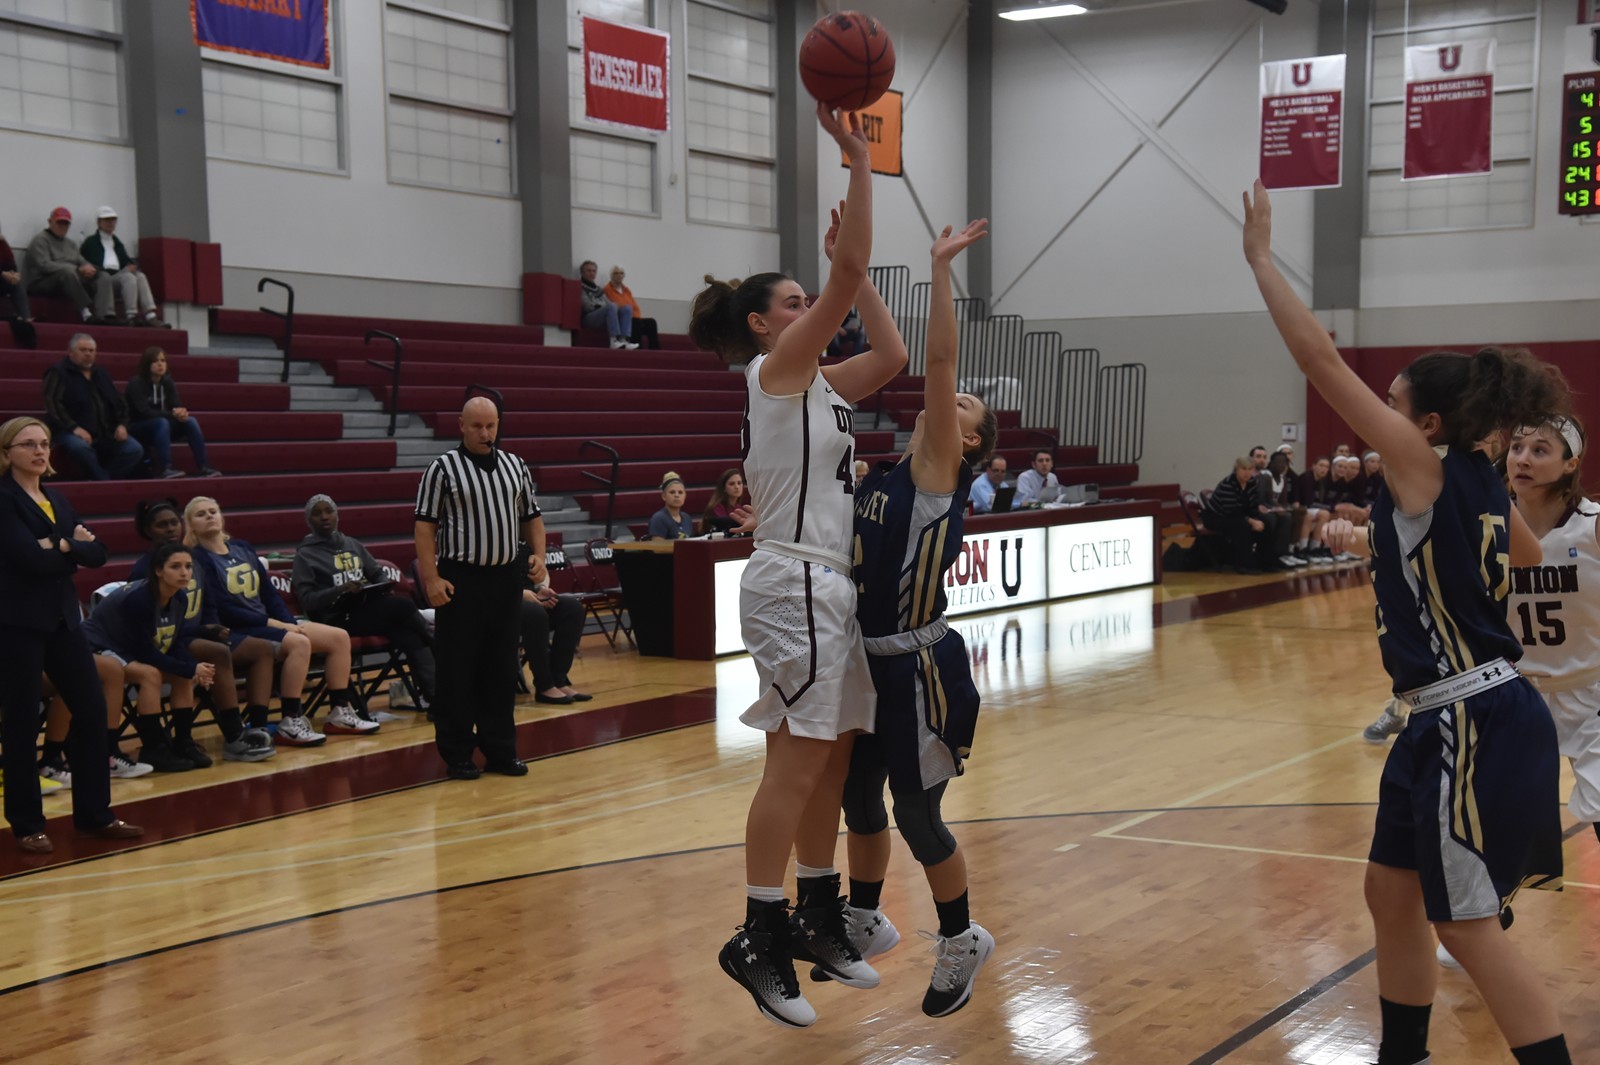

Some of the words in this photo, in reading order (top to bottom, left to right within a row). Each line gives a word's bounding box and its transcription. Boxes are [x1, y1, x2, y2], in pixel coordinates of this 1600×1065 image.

[1438, 45, 1462, 71] U
[588, 51, 664, 99] RENSSELAER
[1292, 63, 1313, 87] U
[1580, 92, 1594, 107] 4
[1579, 116, 1592, 134] 5
[1572, 141, 1592, 158] 15
[1565, 166, 1591, 184] 24
[1564, 190, 1590, 207] 43
[591, 548, 613, 559] UNIO
[1069, 538, 1132, 573] CENTER
[1517, 601, 1566, 646] 15
